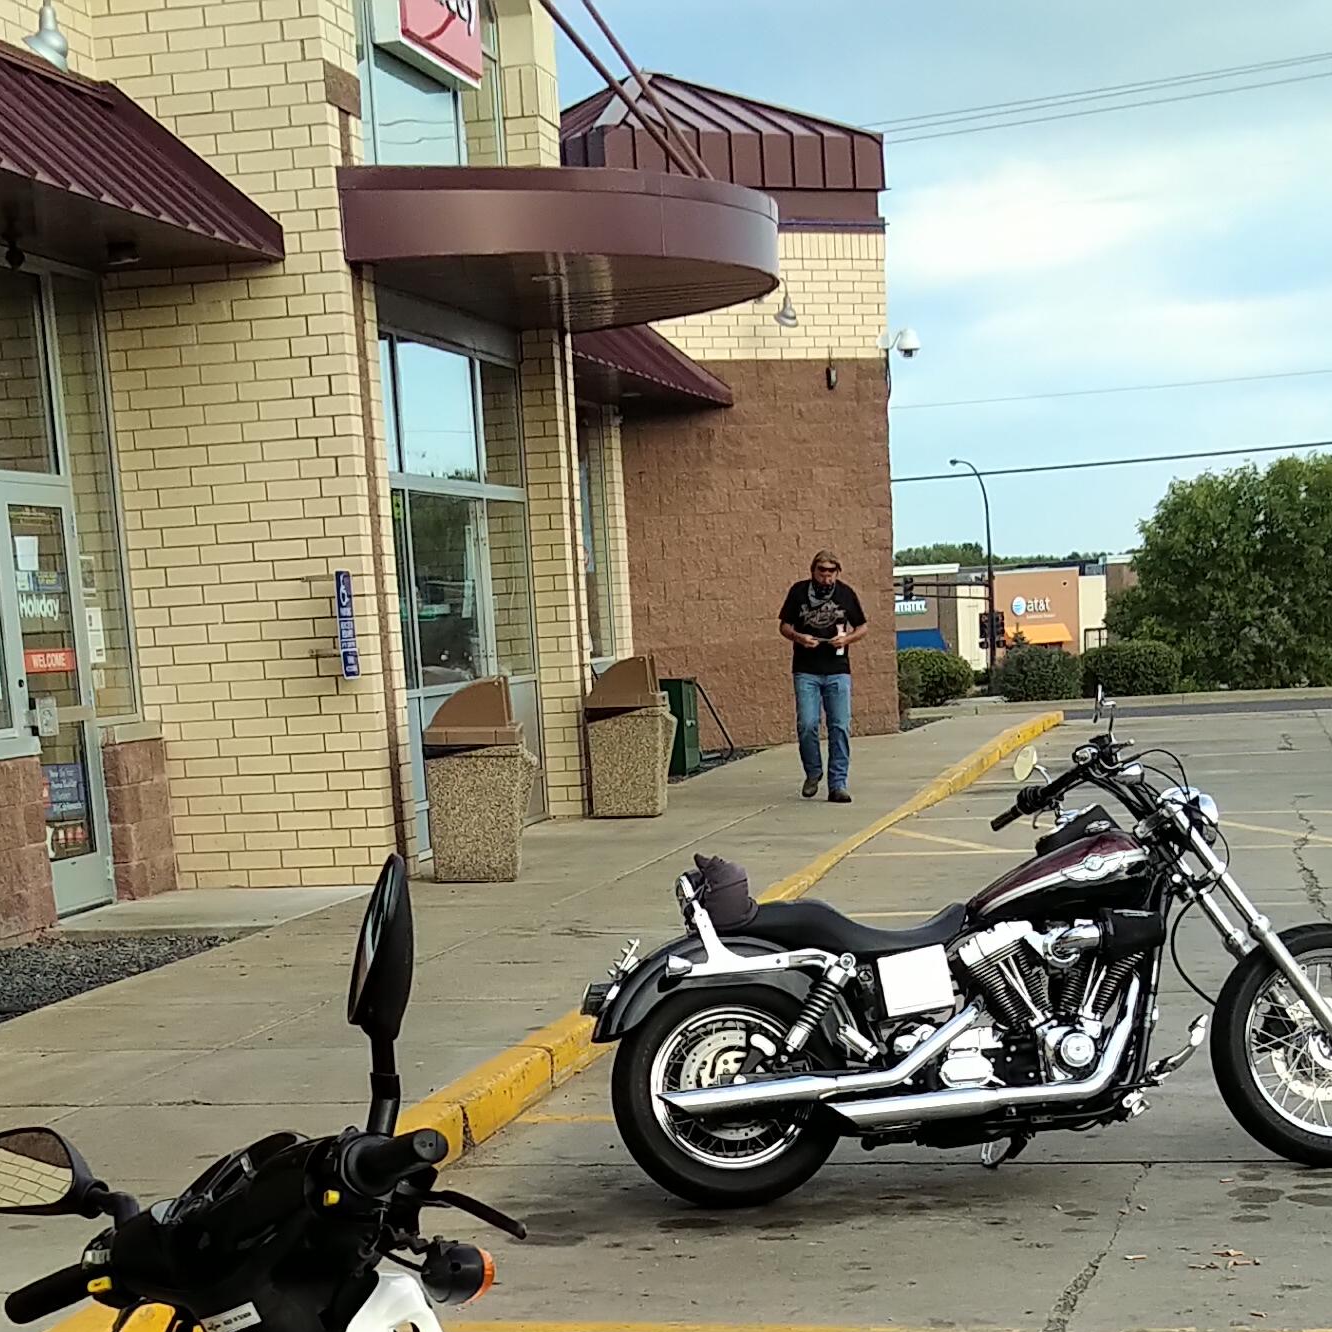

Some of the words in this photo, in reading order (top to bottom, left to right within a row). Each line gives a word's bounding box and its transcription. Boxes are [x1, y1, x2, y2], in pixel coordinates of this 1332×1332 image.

[18, 594, 60, 621] Holiday
[1026, 597, 1051, 612] at&t
[31, 652, 66, 668] WELCOME
